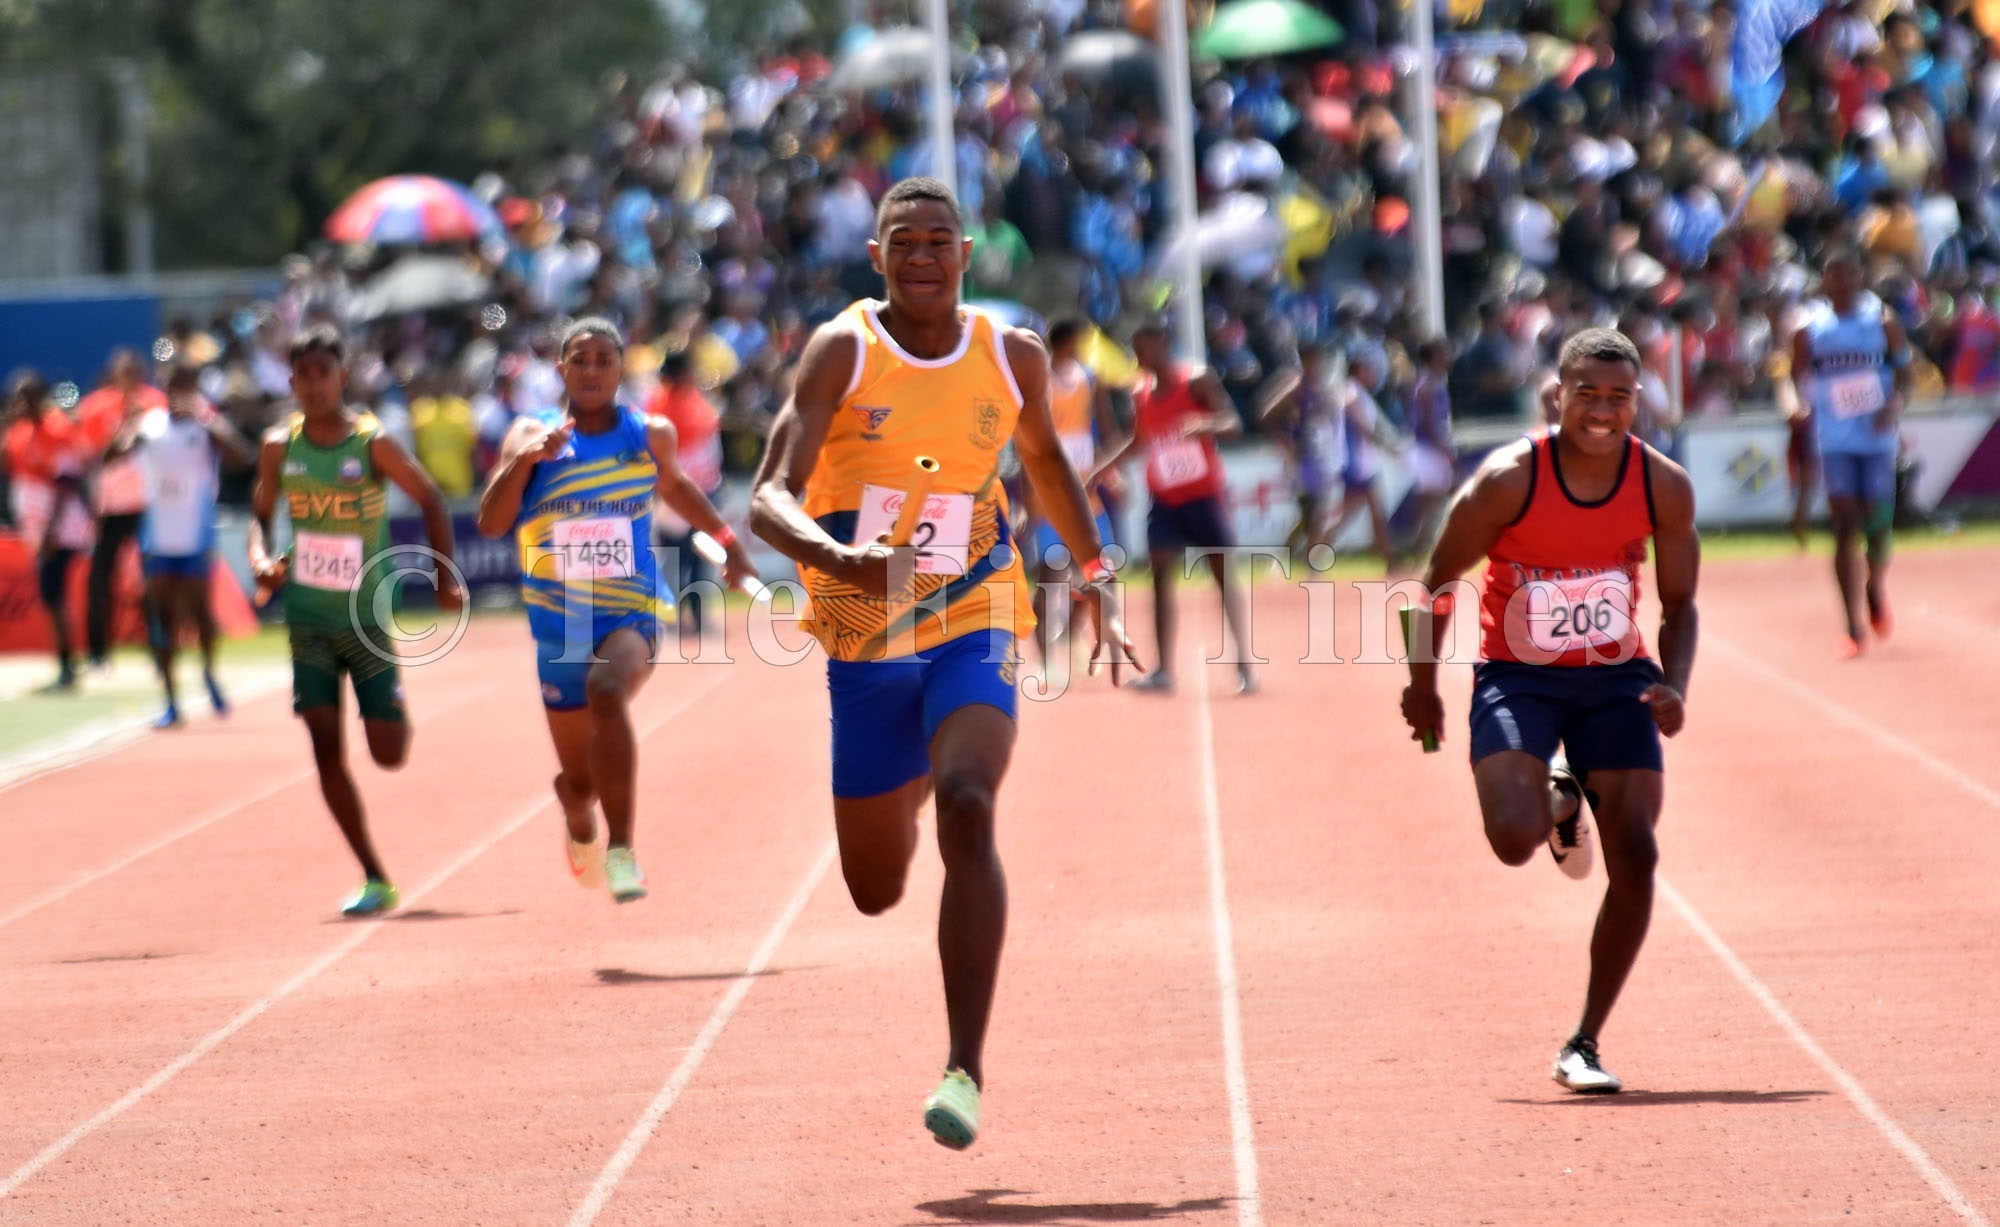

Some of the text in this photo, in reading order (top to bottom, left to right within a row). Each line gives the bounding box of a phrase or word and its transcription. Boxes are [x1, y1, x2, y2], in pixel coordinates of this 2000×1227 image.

[301, 551, 357, 581] 1245
[561, 538, 630, 569] 1498
[1550, 599, 1611, 638] 206
